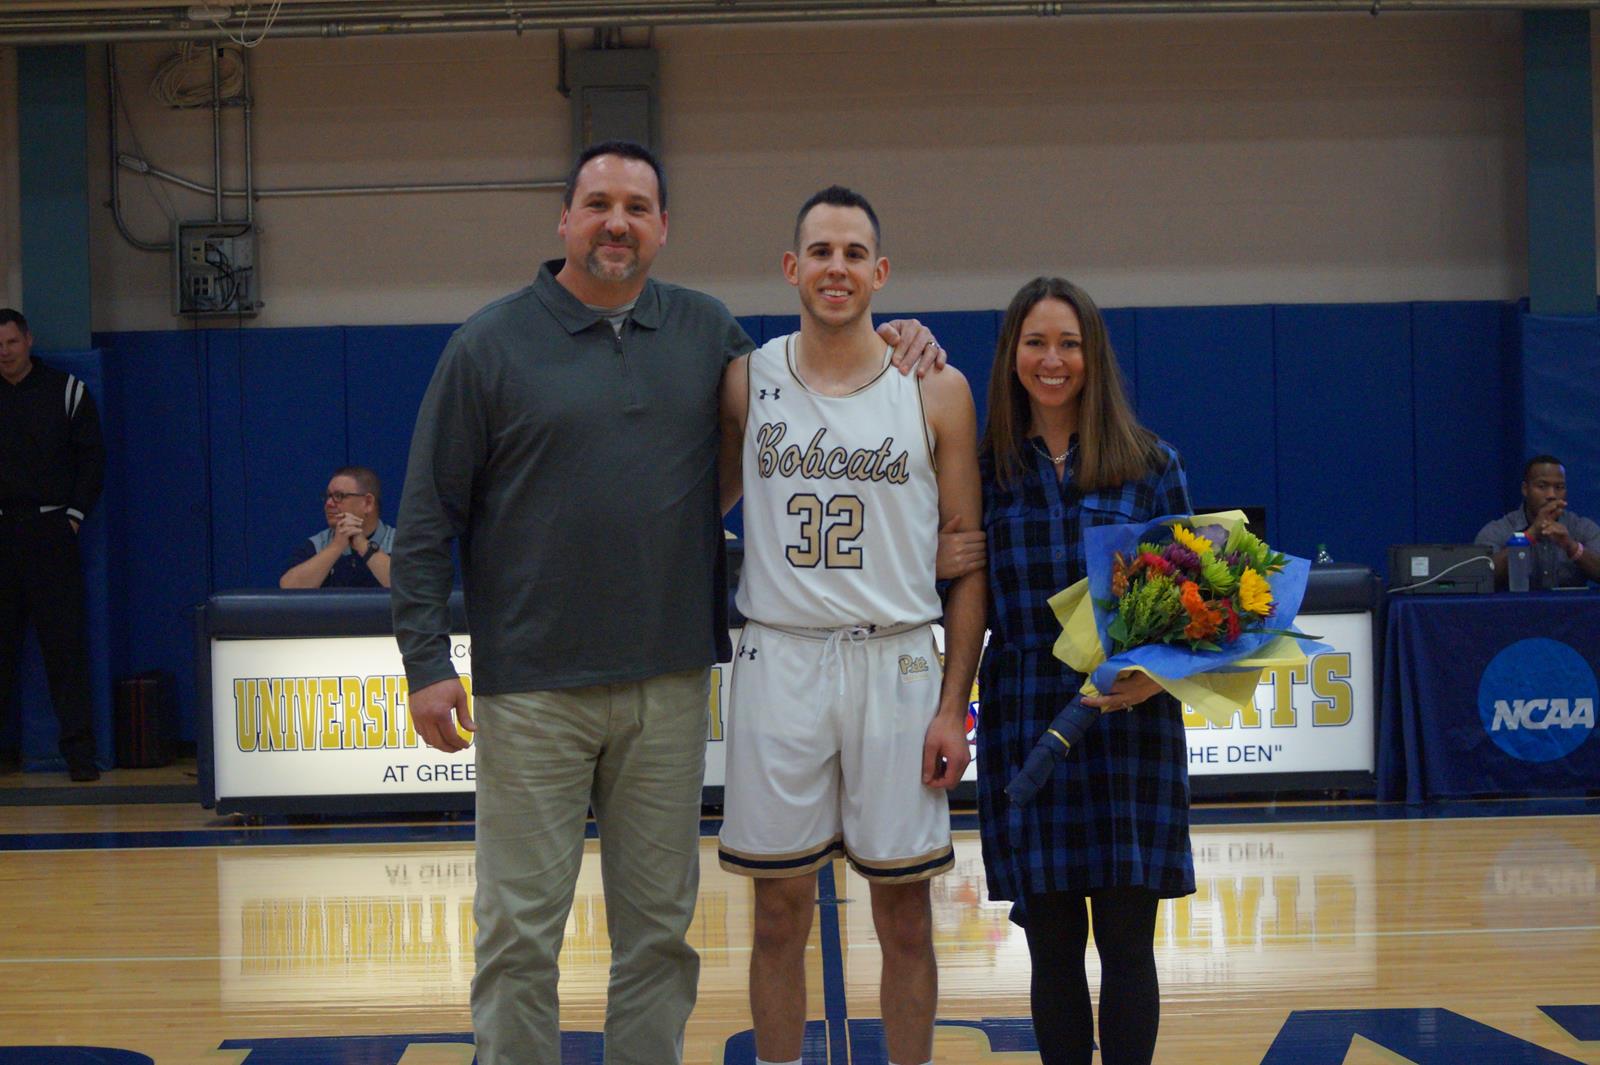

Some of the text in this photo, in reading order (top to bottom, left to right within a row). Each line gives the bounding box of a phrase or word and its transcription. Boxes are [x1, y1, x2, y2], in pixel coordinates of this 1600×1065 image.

[757, 422, 910, 484] Bobcats
[785, 493, 864, 569] 32
[233, 675, 433, 752] UNIVERSIT
[1491, 698, 1595, 731] NCAA
[382, 744, 1282, 782] AT GREE HE DEN"
